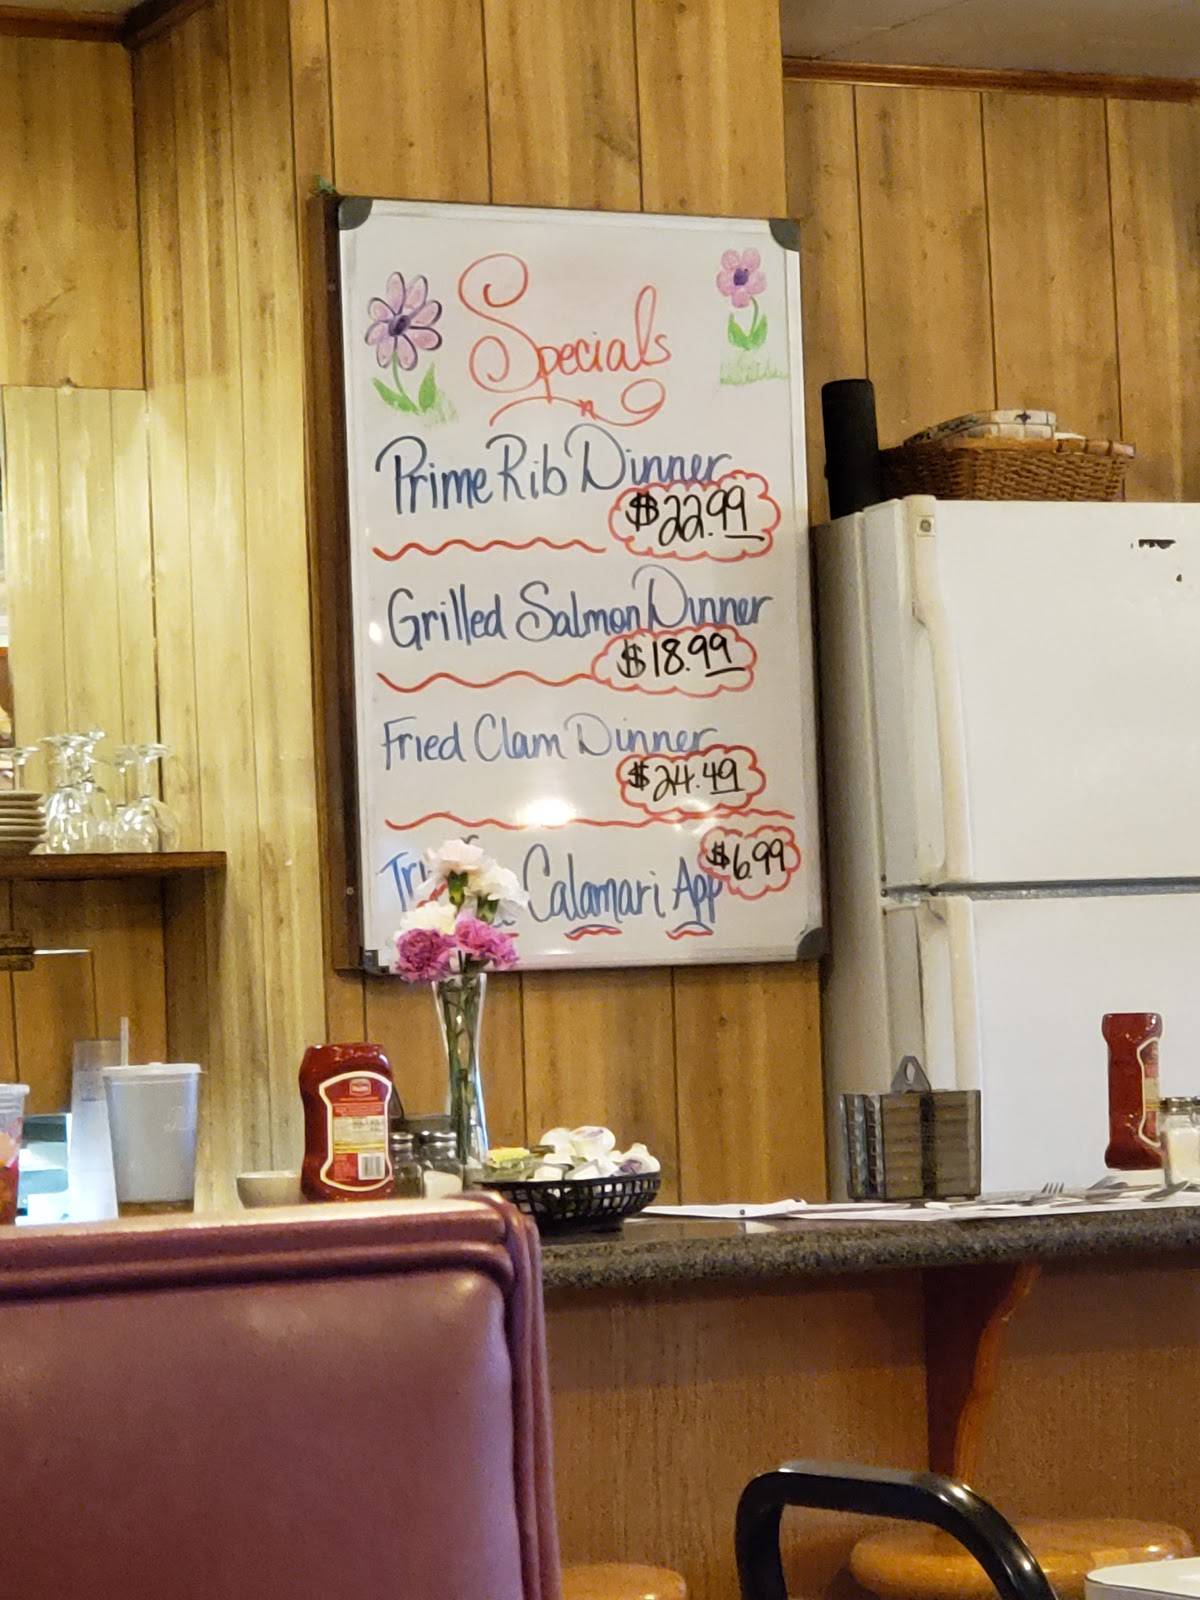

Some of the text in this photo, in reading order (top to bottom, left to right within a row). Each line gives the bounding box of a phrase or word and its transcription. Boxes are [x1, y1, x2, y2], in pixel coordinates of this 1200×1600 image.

[458, 252, 672, 405] Specials
[375, 423, 733, 515] Prime Rib Dinner
[625, 485, 747, 547] $22.99
[388, 563, 773, 651] Grilled Salmon Dinner
[616, 631, 733, 678] $18.99
[383, 711, 719, 770] Fried Clam Dinner
[627, 757, 744, 801] $24.49
[522, 843, 666, 923] Calamari
[672, 857, 723, 924] App
[705, 838, 786, 881] $6.99
